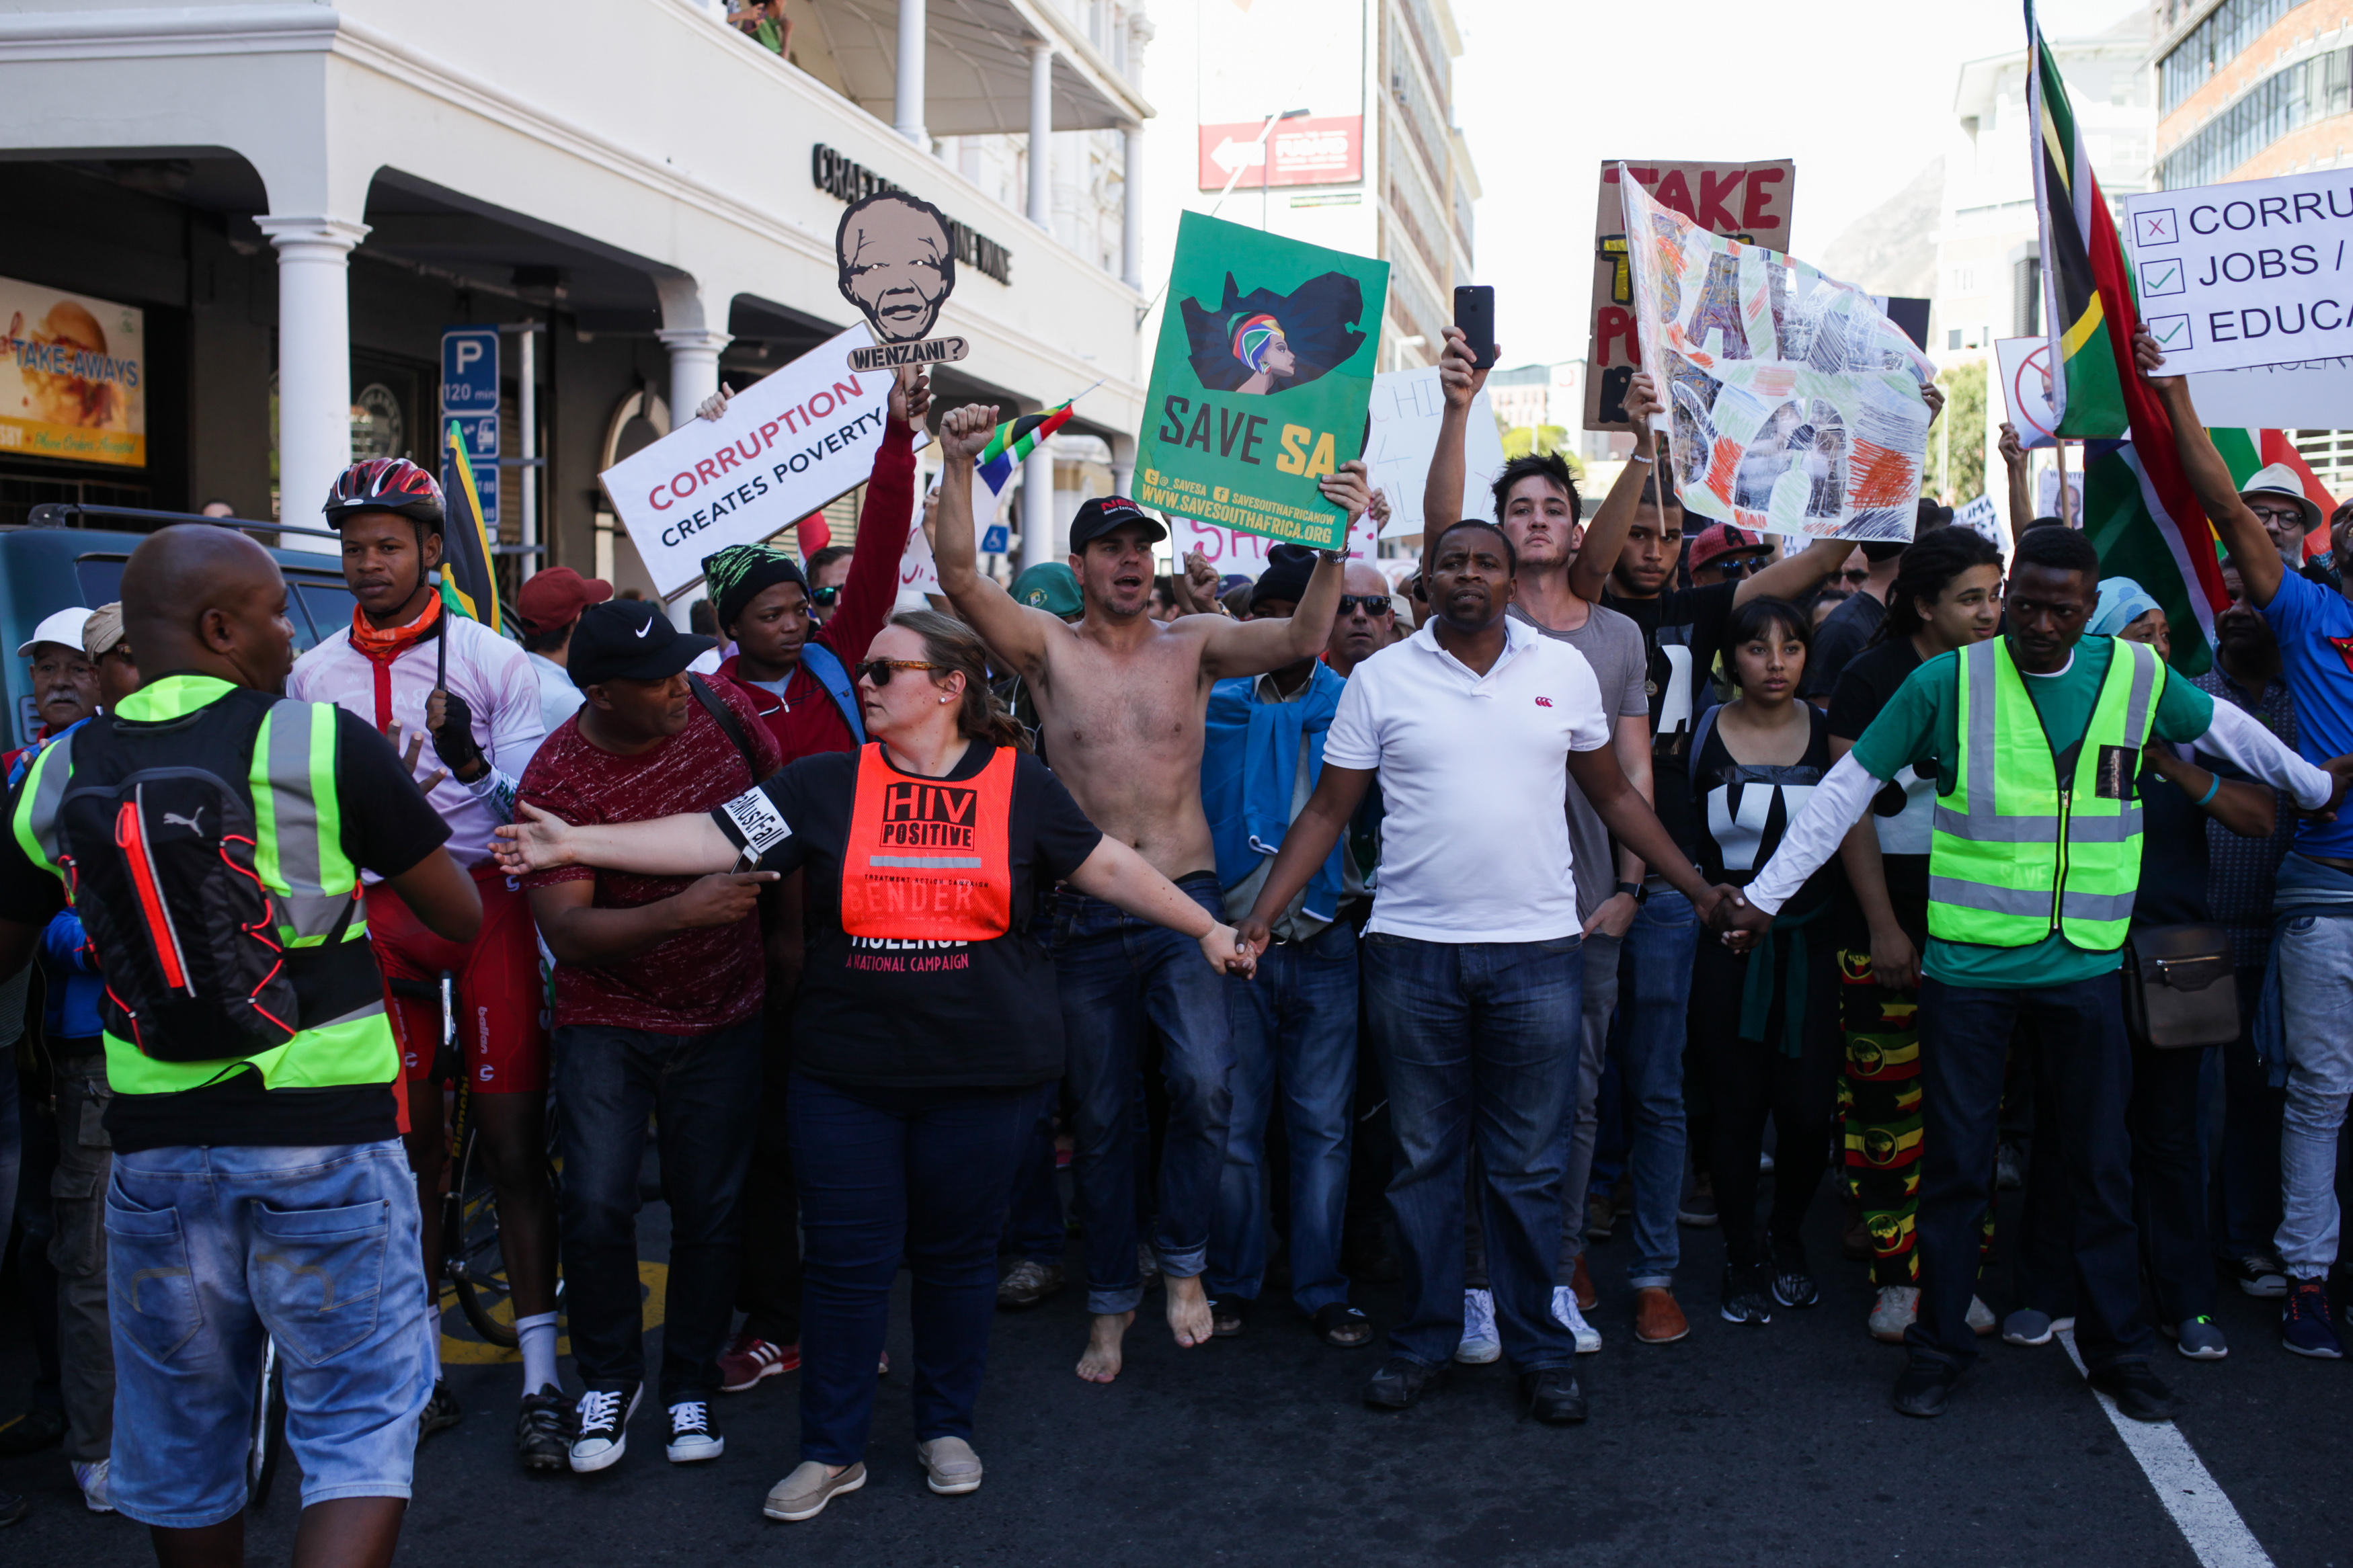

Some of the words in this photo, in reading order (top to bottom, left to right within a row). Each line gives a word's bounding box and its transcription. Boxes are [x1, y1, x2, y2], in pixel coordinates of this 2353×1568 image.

[813, 143, 879, 204] CRAFT
[1603, 167, 1785, 231] TAKE
[2190, 187, 2353, 235] CORRU
[2199, 245, 2319, 286] JOBS
[13, 338, 139, 388] TAKE-AWAYS
[456, 340, 483, 374] P
[444, 383, 471, 401] 120
[475, 386, 496, 400] min
[649, 374, 864, 511] CORRUPTION
[1159, 395, 1268, 465] SAVE
[1276, 423, 1334, 479] SA
[662, 475, 768, 547] CREATES
[772, 407, 883, 483] POVERTY
[2050, 471, 2083, 479] WNTE
[1142, 483, 1332, 544] WWW.SAVESOUTHAFRICA.ORG
[1232, 493, 1336, 526] SAVESOUTHAFRICANOW
[887, 785, 974, 823] HIV
[883, 823, 971, 847] POSITIVE
[848, 880, 973, 913] GENDER
[865, 874, 910, 882] TREATMENT
[915, 876, 944, 885] ACTION
[949, 879, 989, 888] CAMPAIGN
[846, 954, 852, 968] A
[854, 954, 906, 972] NATIONAL
[910, 953, 969, 972] CAMPAIGN
[477, 1006, 490, 1055] ballan
[452, 1075, 469, 1159] Bianchi
